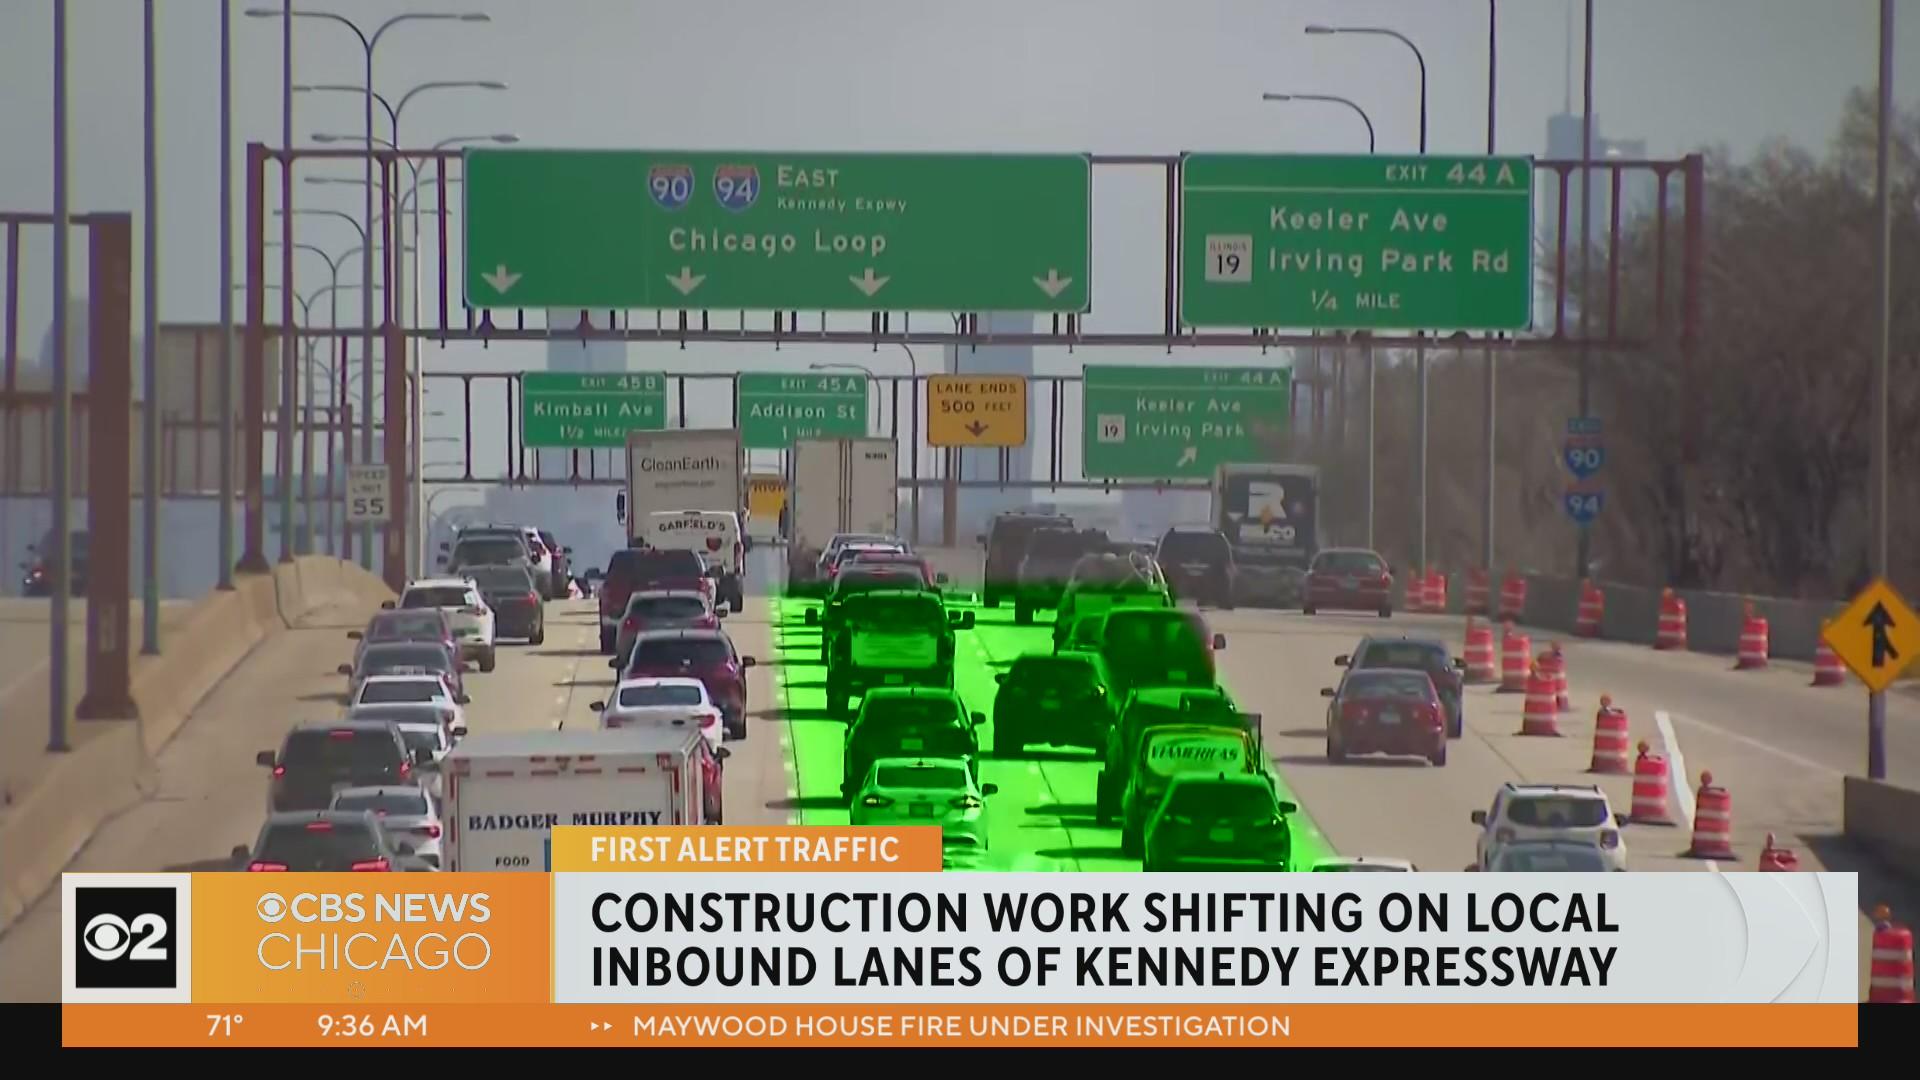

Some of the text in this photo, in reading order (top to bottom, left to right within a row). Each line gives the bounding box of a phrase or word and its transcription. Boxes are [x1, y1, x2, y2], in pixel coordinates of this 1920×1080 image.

[777, 165, 839, 187] EAST
[1386, 165, 1427, 182] EXIT
[652, 176, 689, 201] 90
[717, 177, 753, 202] 94
[777, 197, 907, 213] Kennedy Expwy
[1270, 208, 1448, 232] Keeler Ave
[669, 227, 887, 258] Chicago Loop
[1217, 254, 1240, 275] 19
[1268, 249, 1509, 277] Irving Park Rd
[1356, 294, 1400, 308] MILE
[937, 383, 1017, 394] LANE ENDS
[533, 402, 654, 417] Kimball Ave
[750, 403, 857, 420] Addison St
[941, 400, 975, 413] 500
[1136, 398, 1241, 413] Keeler Ave
[1104, 424, 1119, 438] 19
[1136, 422, 1192, 440] Irving
[1202, 422, 1245, 438] Park
[641, 456, 720, 472] CleanEarth
[353, 498, 385, 516] 55
[468, 811, 663, 831] BADGER MURPHY
[495, 856, 531, 868] FOOD
